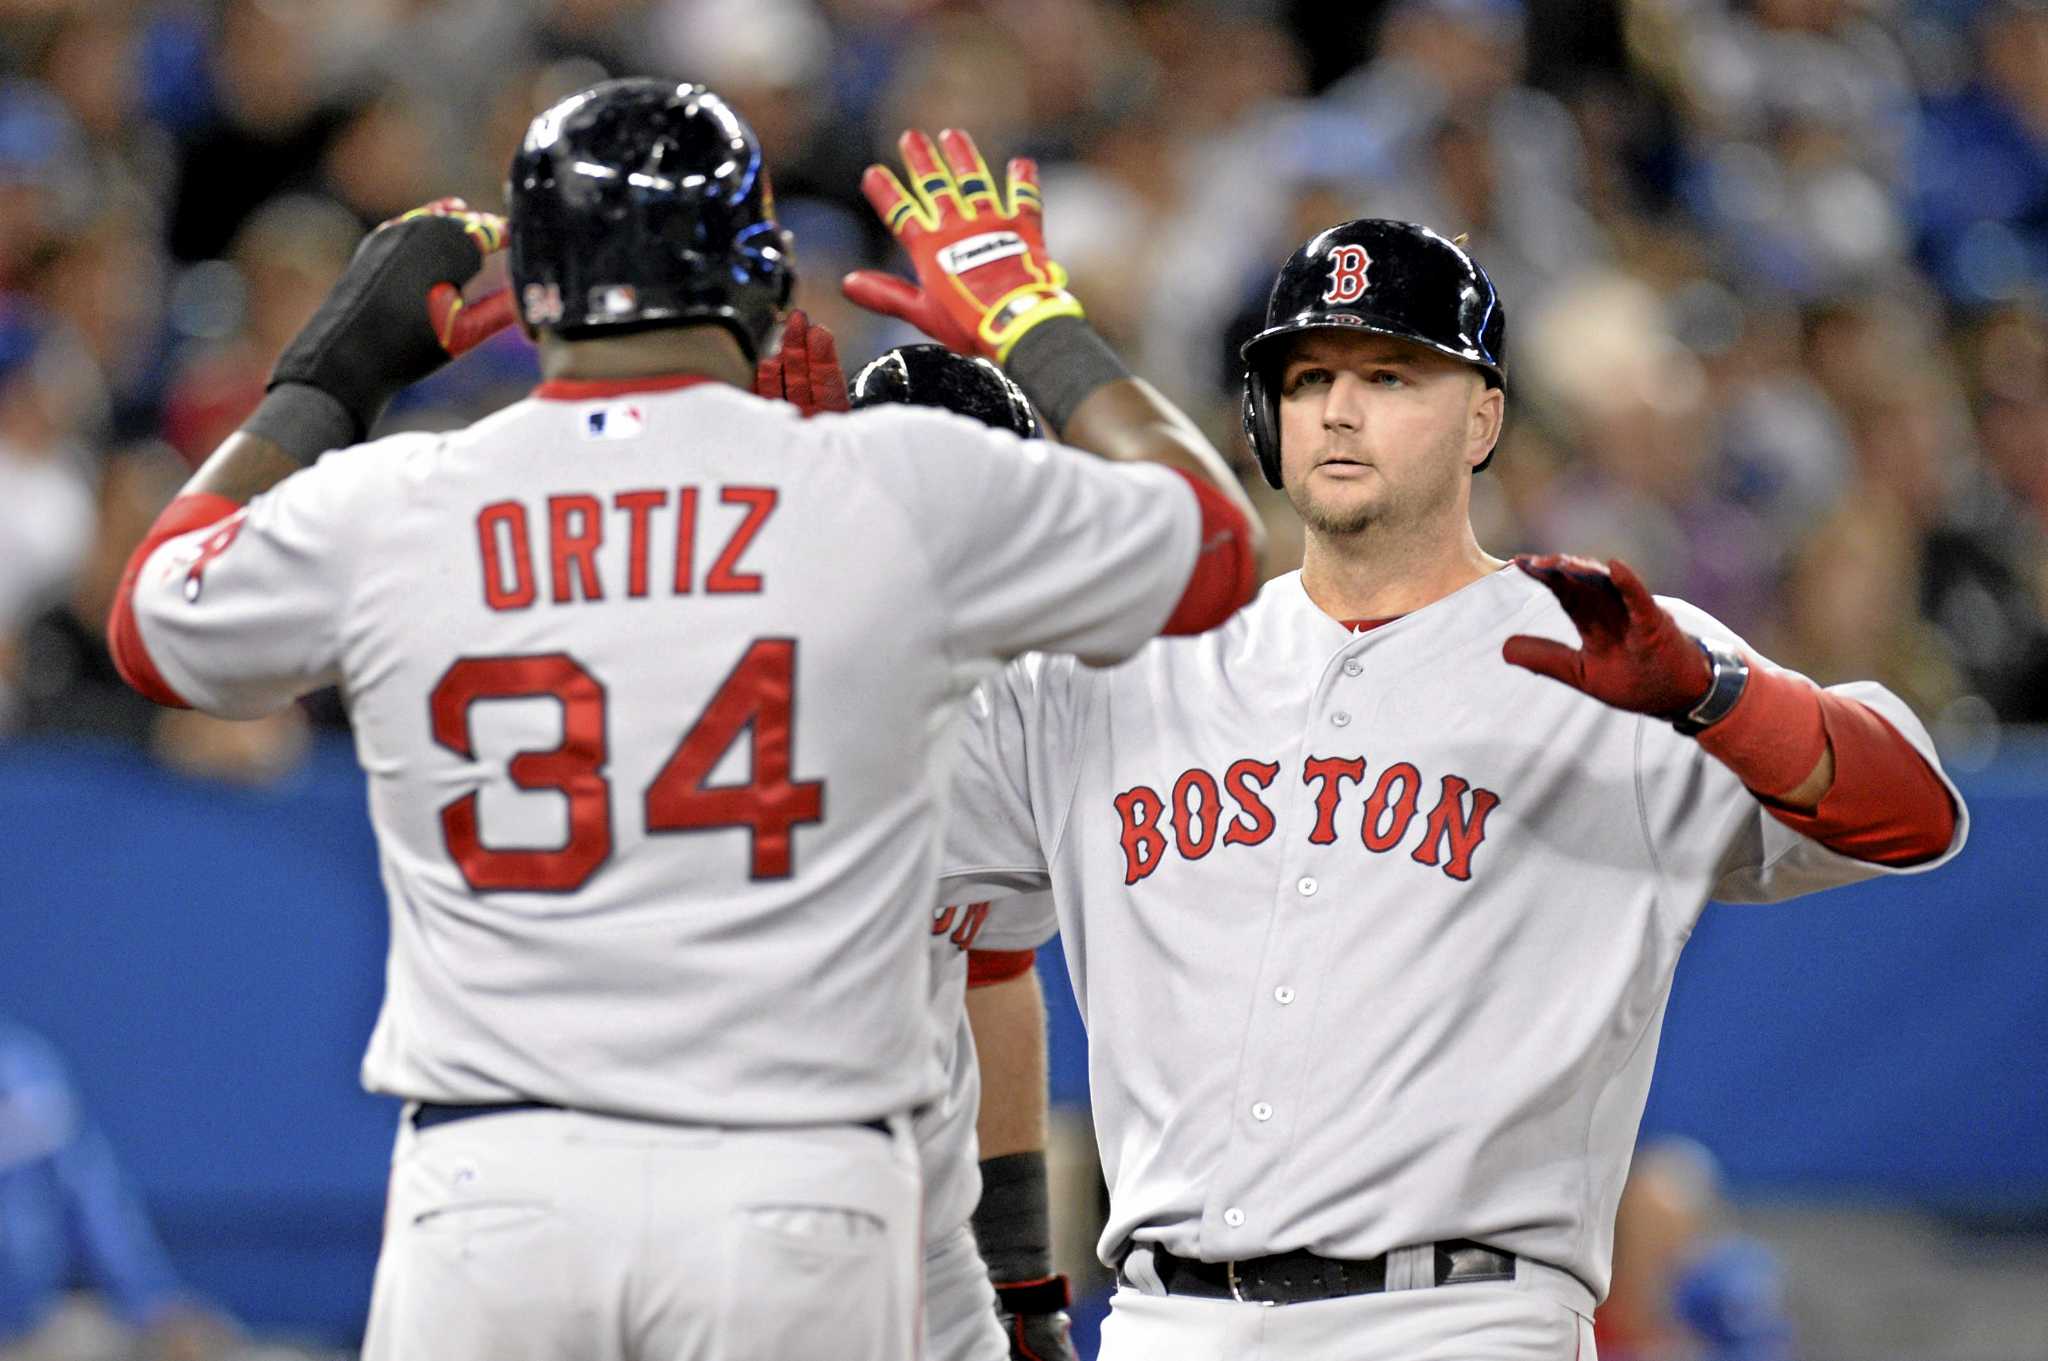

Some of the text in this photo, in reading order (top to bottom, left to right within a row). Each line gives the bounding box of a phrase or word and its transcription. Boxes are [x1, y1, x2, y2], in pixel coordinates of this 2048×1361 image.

[1322, 244, 1374, 304] B
[475, 485, 780, 612] ORTIZ
[428, 637, 827, 895] 34
[1113, 755, 1501, 886] BOSTON
